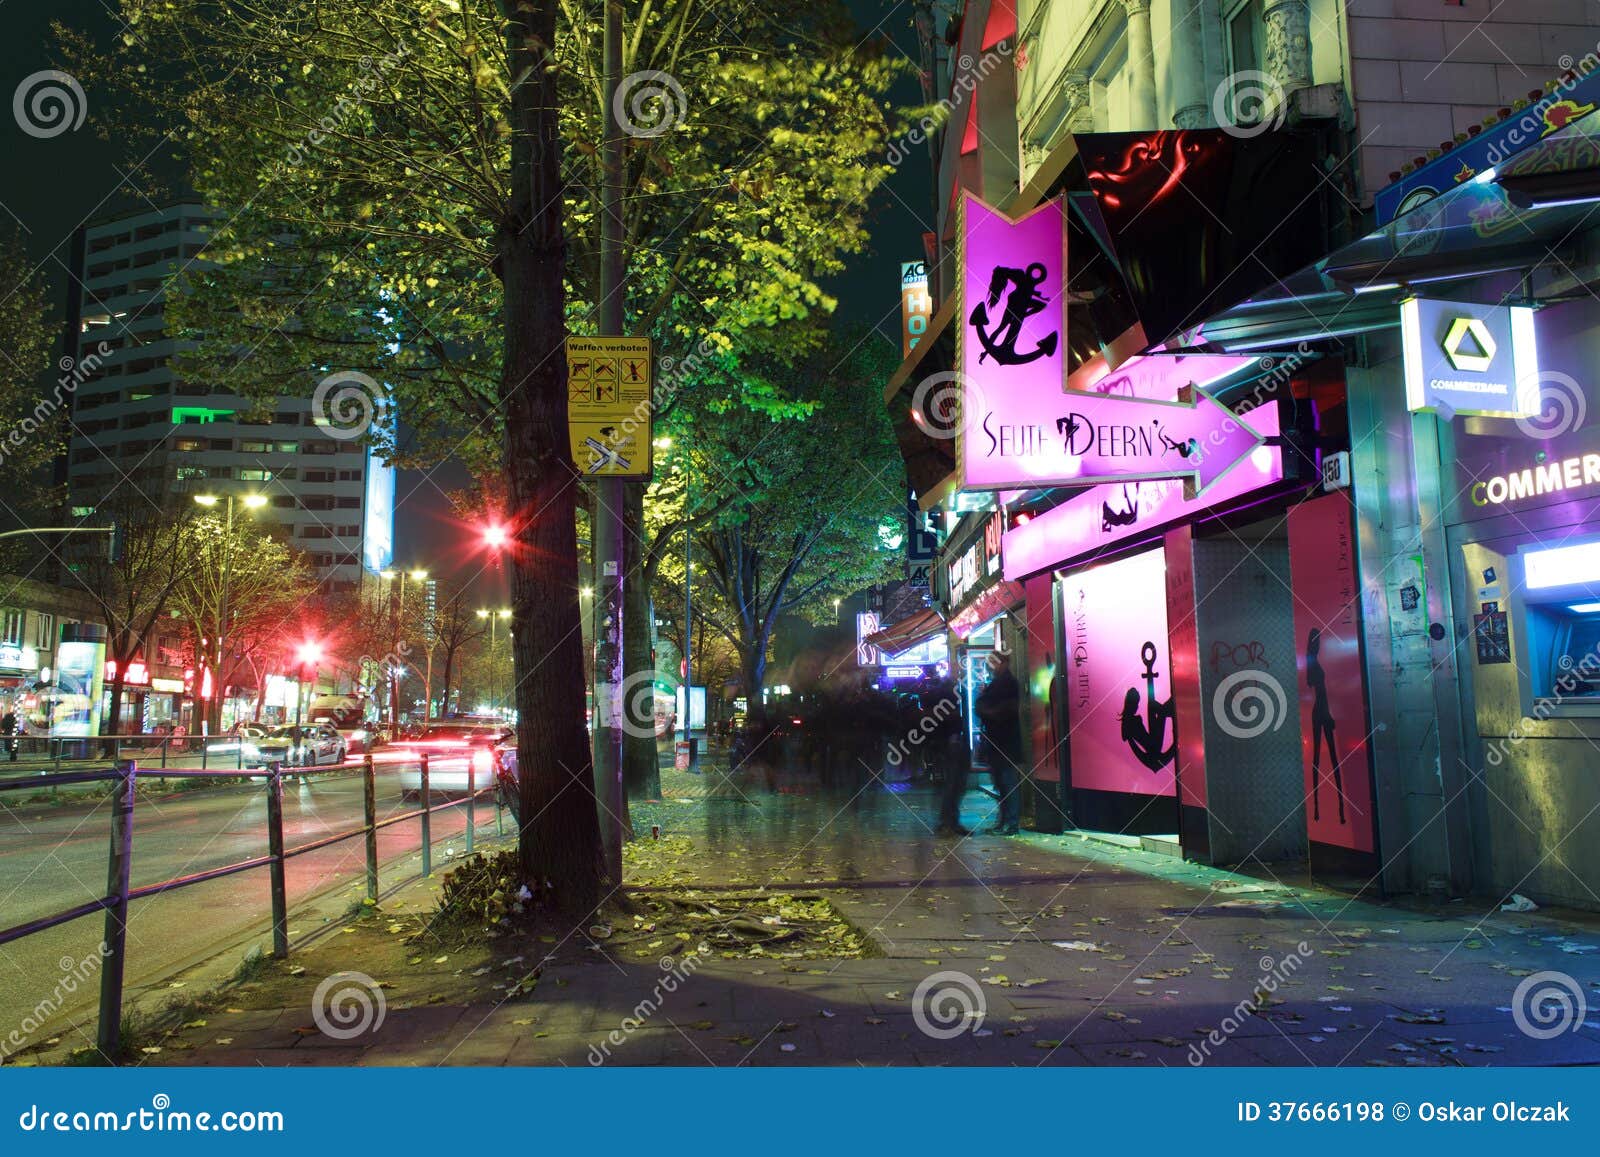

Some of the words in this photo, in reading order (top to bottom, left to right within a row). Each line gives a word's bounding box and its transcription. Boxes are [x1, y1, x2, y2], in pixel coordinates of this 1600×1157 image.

[569, 344, 602, 352] Waffen
[605, 344, 648, 352] verboten
[1324, 458, 1340, 483] 150
[1471, 453, 1600, 507] COMMER
